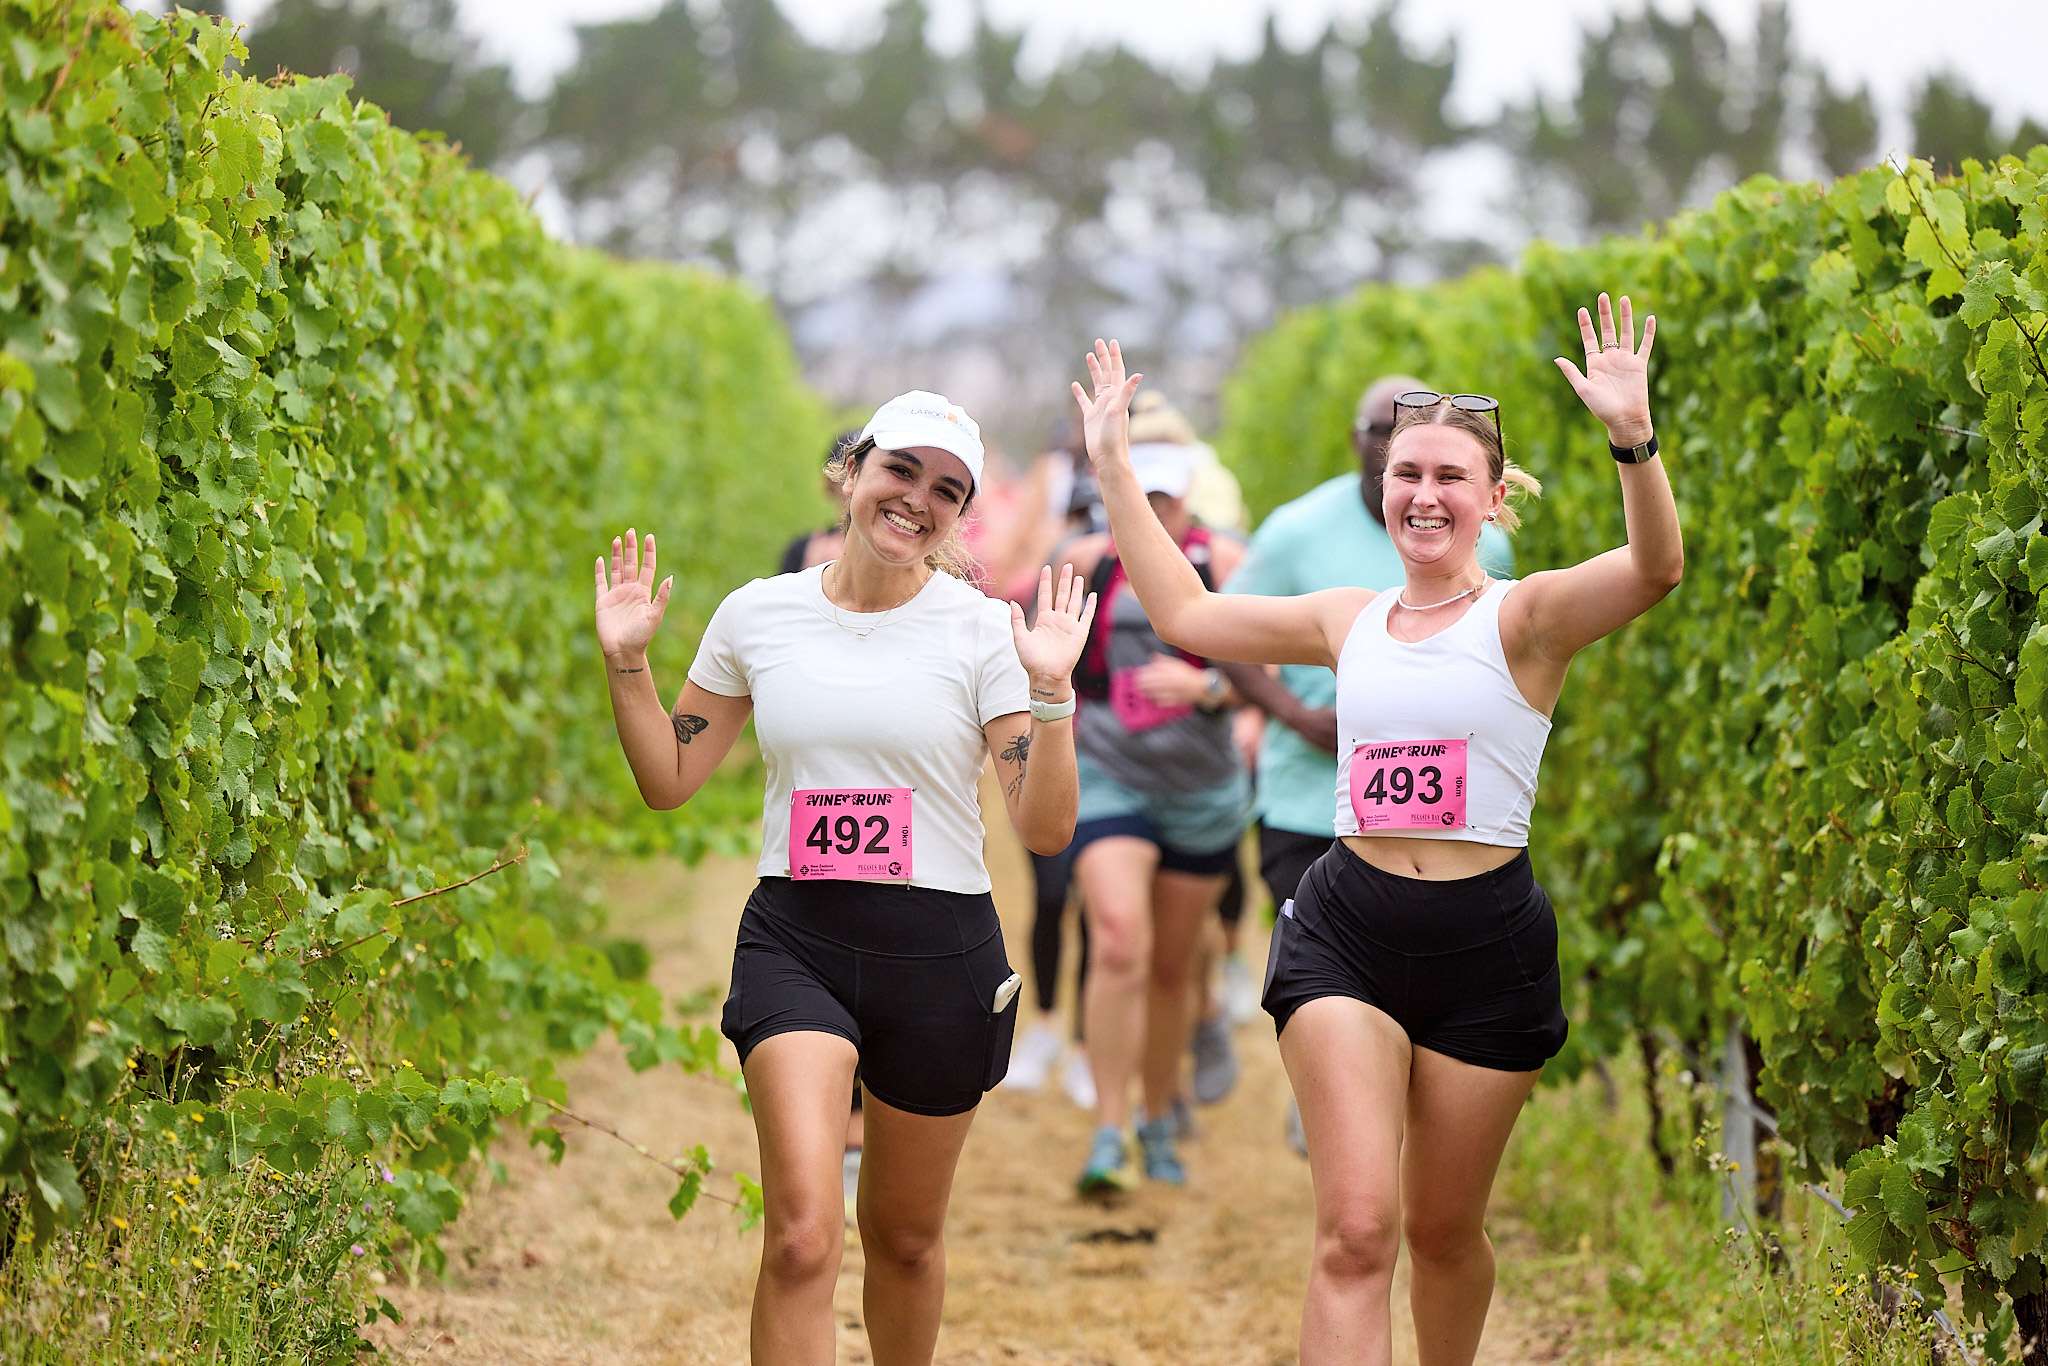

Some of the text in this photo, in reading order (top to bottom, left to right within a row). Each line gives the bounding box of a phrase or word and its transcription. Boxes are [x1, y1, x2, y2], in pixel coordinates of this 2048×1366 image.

[1368, 744, 1444, 760] VINE RUN
[1363, 765, 1443, 805] 493
[1455, 775, 1463, 797] 10km
[808, 793, 890, 807] VINE RUN
[806, 815, 890, 855] 492
[901, 825, 909, 847] 10km
